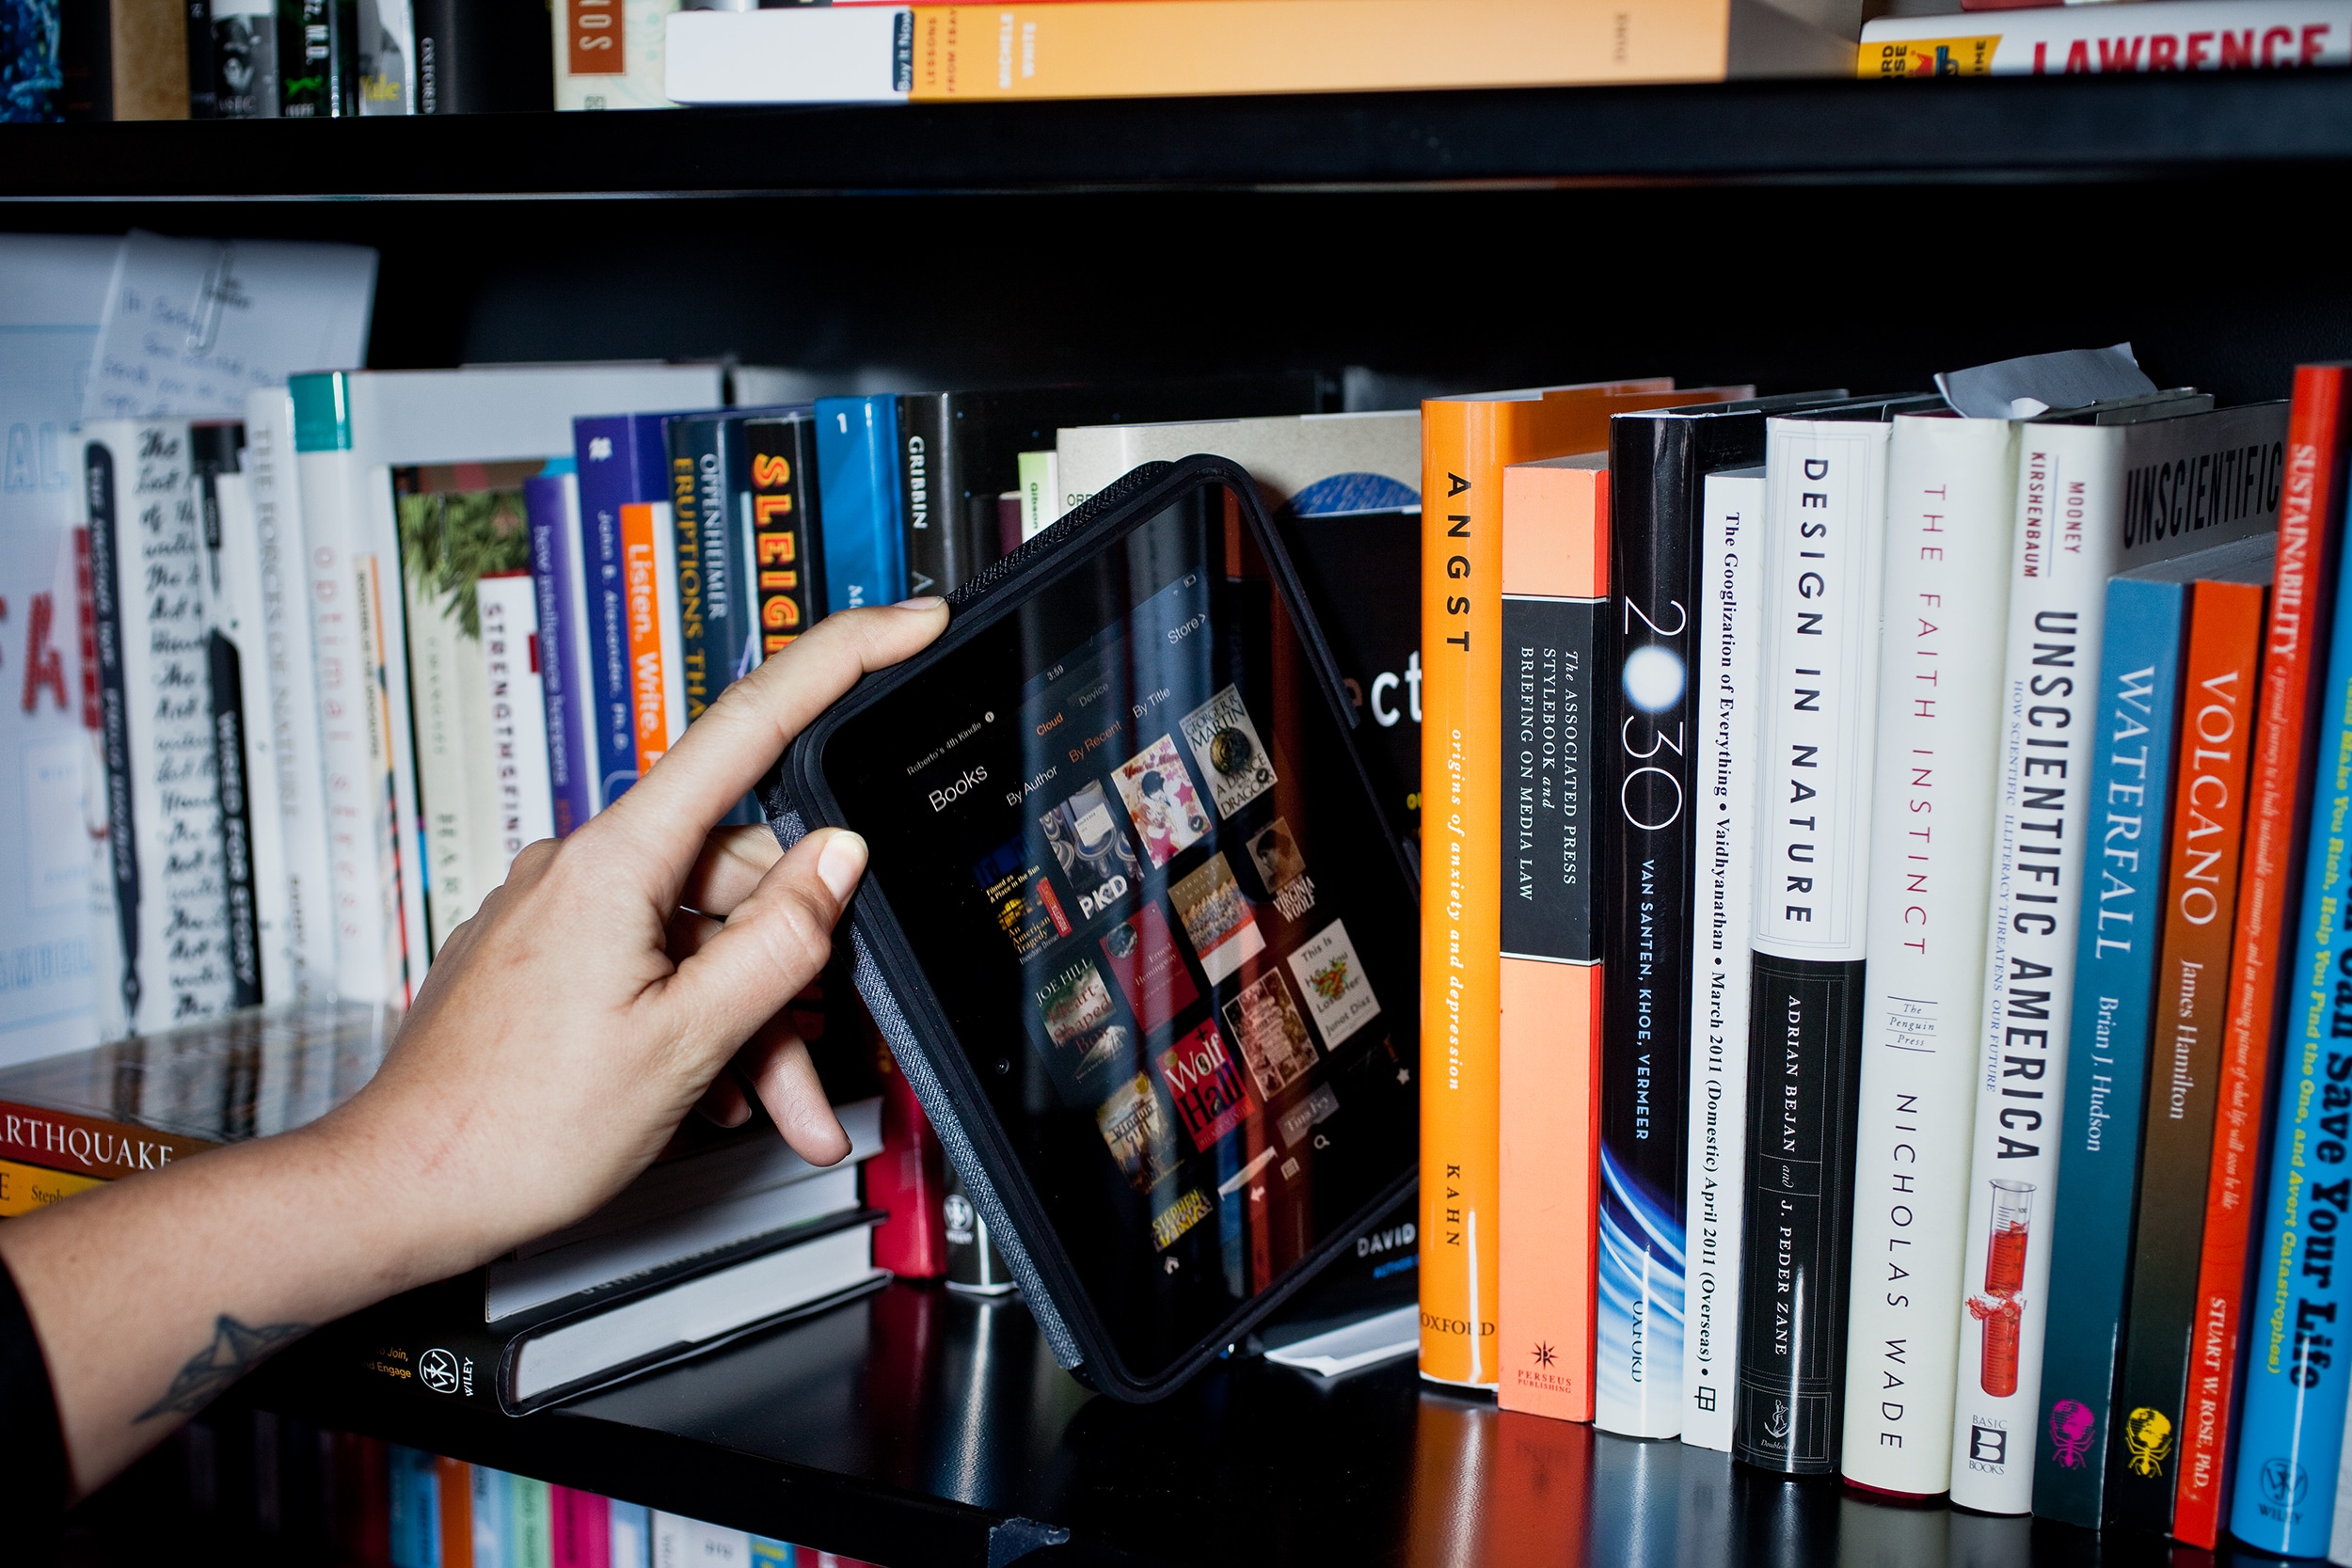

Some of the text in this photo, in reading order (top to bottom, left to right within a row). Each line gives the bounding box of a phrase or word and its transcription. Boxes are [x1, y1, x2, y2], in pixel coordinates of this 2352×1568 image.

[897, 63, 913, 91] Buy
[998, 12, 1014, 88] MICHELE
[1022, 22, 1037, 78] WHITE
[2032, 23, 2330, 76] LAWRENCE
[835, 411, 848, 436] 1
[908, 436, 929, 531] GRIBBIN
[2123, 440, 2283, 551] UNSCIENTIFIC
[699, 452, 729, 621] OPPENHEIMER
[2023, 451, 2047, 578] KIRSHENBAUM
[2064, 482, 2086, 554] MOONEY
[2271, 441, 2318, 662] SUSTAINABILITY
[627, 545, 653, 643] Listen.
[673, 458, 710, 721] ERUPTIONS THA
[1168, 616, 1200, 646] Store
[635, 651, 663, 740] Write.
[1036, 681, 1109, 736] Cloud Device
[1132, 704, 1148, 719] By
[1146, 687, 1170, 708] Title
[1786, 459, 1829, 923] DESIGN IN NATURE
[1903, 484, 1947, 955] THE FAITH INSTINCT
[483, 602, 523, 861] STRENGTHSFIND
[1068, 721, 1122, 764] By Recent
[1190, 705, 1246, 752] MARTIN
[1541, 648, 1557, 809] STYLEBOOK and
[928, 766, 988, 813] Books
[1006, 765, 1058, 806] By Author
[1518, 646, 1534, 901] BRIEFING ON MEDIA LAW
[1563, 651, 1579, 885] The ASSOCIATED PRESS
[2329, 795, 2349, 832] You
[224, 817, 247, 883] FOR
[1446, 472, 1471, 1246] ANGST origins of anxiety and depression KAHN
[1641, 858, 1655, 896] VAN
[2323, 836, 2344, 891] Rich,
[1076, 874, 1129, 921] PKD
[1986, 680, 2024, 1092] HOW SCIENTIFIC ILLITERACY THREATENS OUR FUTURE
[1996, 610, 2079, 1161] UNSCIENTIFIC AMERICA
[2086, 666, 2155, 1153] WATERFALL Brian J. Hudson
[2169, 672, 2239, 1120] VOLCANO James Hamilton
[1639, 901, 1654, 982] SANTEN,
[1696, 512, 1740, 1362] The Googlization of Everything Vaidhyanathan March 2011 (Domestic) April 2011 (Overseas)
[2315, 895, 2338, 945] Help
[1035, 956, 1093, 1007] JOE HILL
[2312, 949, 2331, 987] You
[1637, 989, 1652, 1047] KHOE,
[1889, 1017, 1935, 1032] Penguin
[1903, 1004, 1922, 1015] The
[2306, 990, 2326, 1039] Find
[1165, 1032, 1226, 1094] Wolf
[1897, 1034, 1926, 1046] Press
[2301, 1041, 2319, 1076] the
[1179, 1058, 1245, 1136] Hall
[1635, 1054, 1651, 1141] VERMEER
[2294, 1079, 2315, 1125] One,
[1773, 995, 1801, 1355] ADRIAN BEJAN and J. PEDER ZANE
[2290, 1129, 2307, 1167] and
[2283, 1170, 2304, 1227] Avert
[2289, 1052, 2352, 1390] Save Your Life
[1357, 1222, 1416, 1258] DAVID
[1880, 1094, 1917, 1449] NICHOLAS WADE
[2267, 1230, 2297, 1375] Catastrophes)
[387, 1346, 409, 1363] Join,
[1631, 1301, 1649, 1384] OXFORD
[2203, 1296, 2226, 1370] STUART
[376, 1361, 412, 1380] Engage
[463, 1356, 474, 1397] WILEY
[1518, 1370, 1572, 1386] PERSEUS
[1518, 1378, 1572, 1394] PUBLISHING
[2202, 1374, 2220, 1396] W.
[1972, 1414, 2008, 1430] BASIC
[1968, 1461, 2005, 1476] BOOKS
